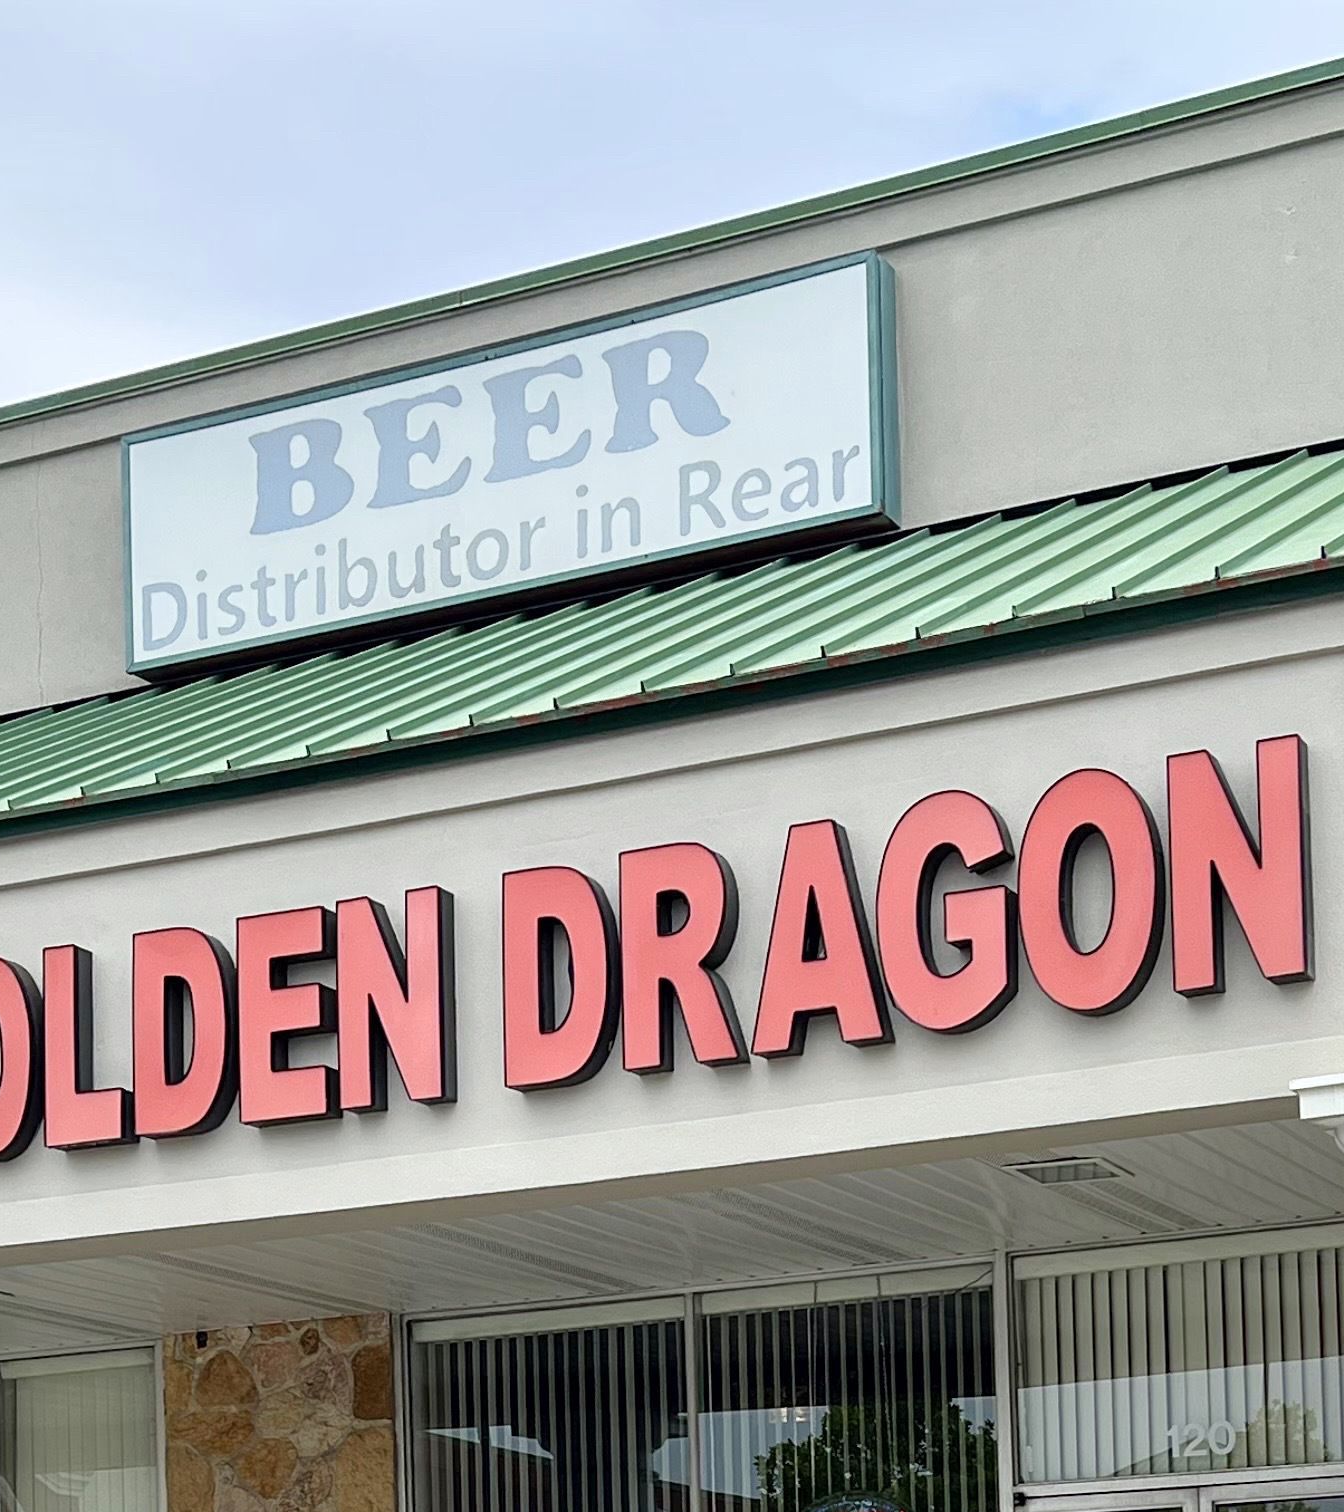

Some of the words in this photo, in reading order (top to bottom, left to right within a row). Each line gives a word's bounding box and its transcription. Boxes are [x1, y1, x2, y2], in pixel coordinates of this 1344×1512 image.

[248, 328, 731, 536] BEER
[140, 516, 547, 653] Distributor
[576, 484, 641, 560] in
[678, 445, 861, 537] Rear
[500, 733, 1316, 1093] DRAGON
[1167, 1420, 1235, 1458] 120
